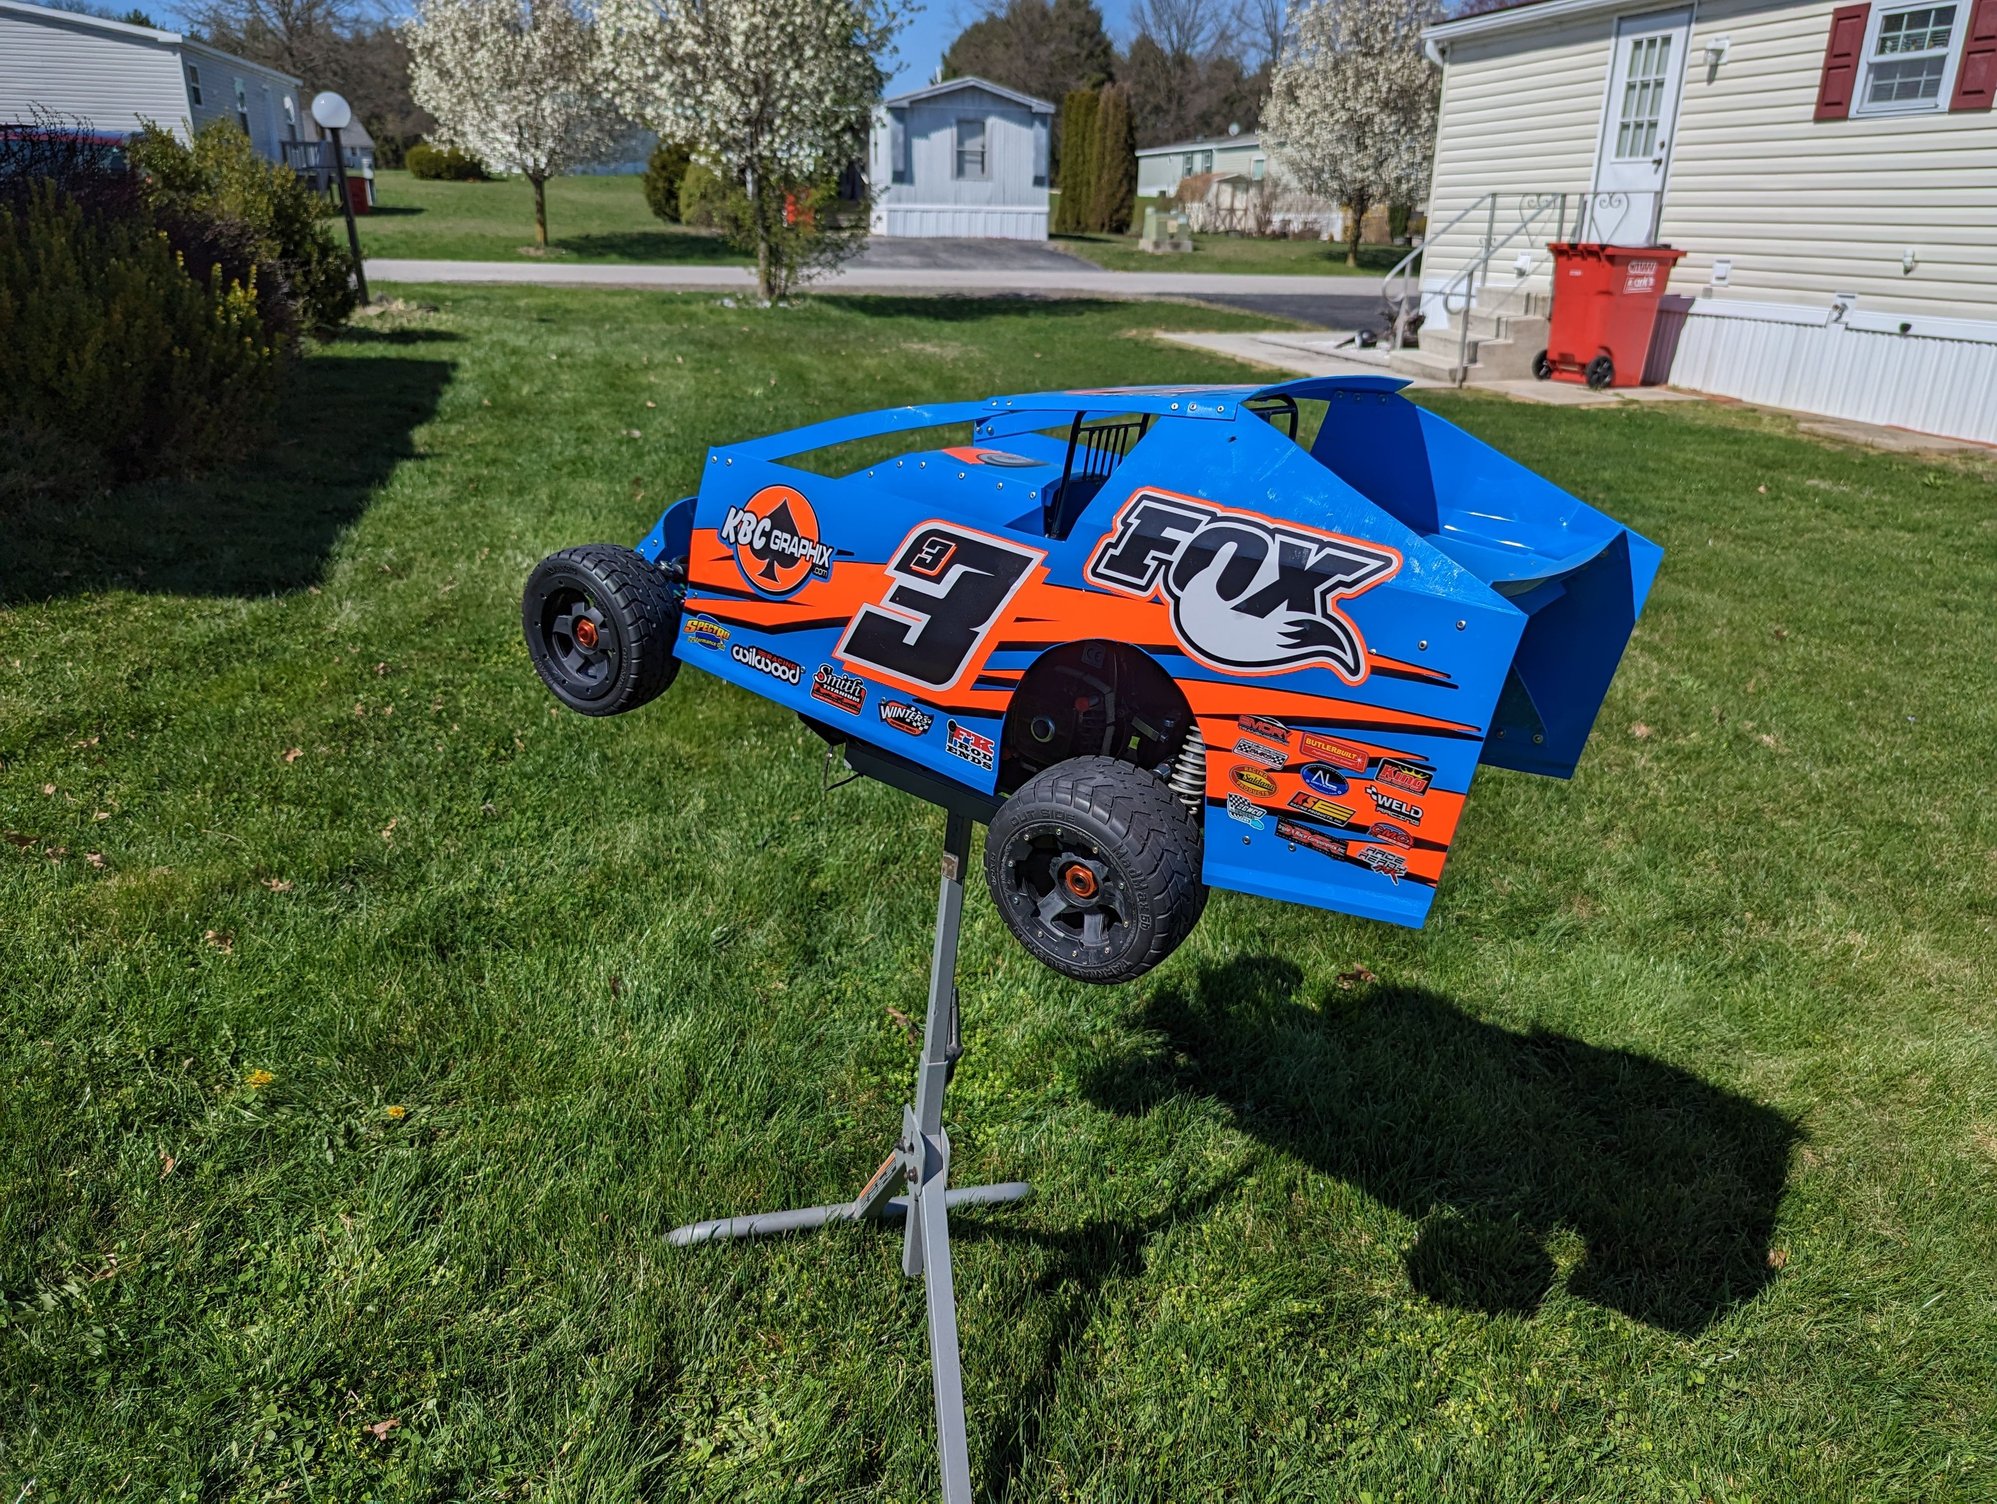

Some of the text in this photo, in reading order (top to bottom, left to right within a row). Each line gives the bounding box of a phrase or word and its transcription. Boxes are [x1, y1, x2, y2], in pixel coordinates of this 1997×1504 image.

[721, 507, 833, 568] KBC GRAPHIX
[912, 537, 956, 574] 3
[1092, 494, 1396, 622] FOX
[813, 566, 828, 578] .com
[838, 522, 1046, 690] 3
[683, 619, 731, 641] SPECTRO
[732, 645, 801, 684] wilwood
[766, 653, 798, 671] RACING
[814, 665, 863, 697] Smith
[822, 683, 861, 703] TITANIUM
[880, 704, 930, 725] WINTERS
[952, 726, 995, 755] FK
[957, 741, 993, 762] ROD
[1305, 737, 1358, 760] BUTLERBUILT
[946, 744, 993, 771] ENDS
[1242, 773, 1275, 791] Saldana
[1243, 766, 1269, 779] RACING
[1378, 764, 1429, 792] King
[1236, 781, 1270, 797] PRODUCTS
[1010, 807, 1077, 827] OUT SIDE
[1289, 802, 1308, 812] RACING
[1292, 793, 1355, 822] KSE
[1377, 794, 1423, 818] WELD
